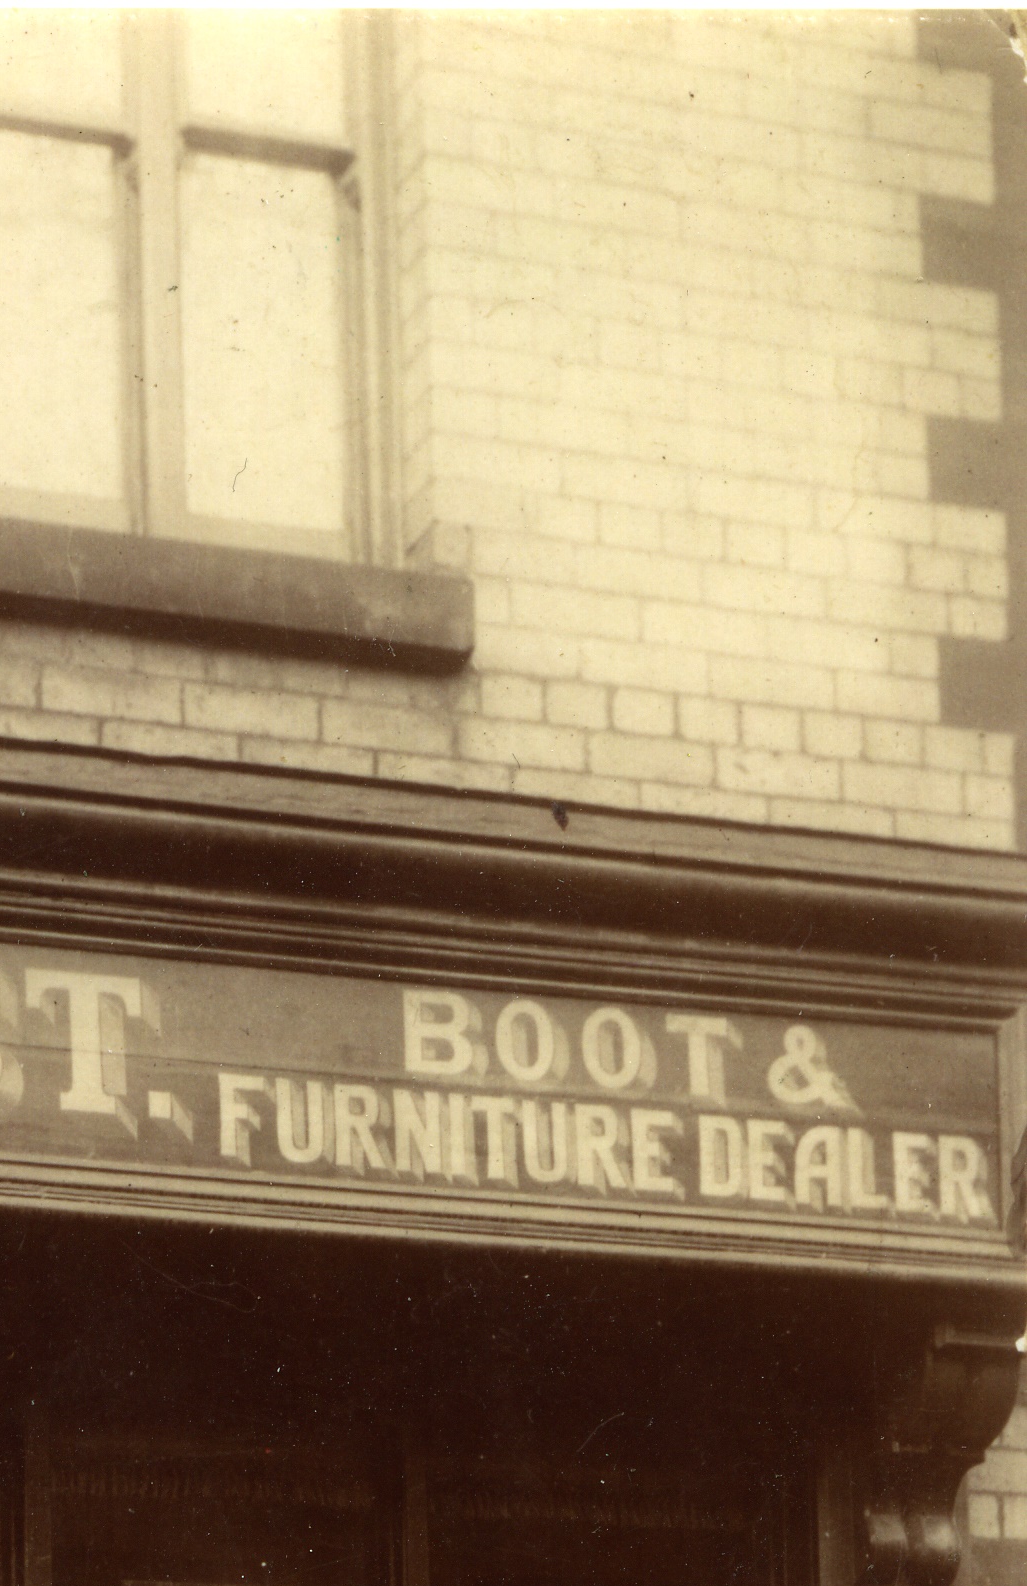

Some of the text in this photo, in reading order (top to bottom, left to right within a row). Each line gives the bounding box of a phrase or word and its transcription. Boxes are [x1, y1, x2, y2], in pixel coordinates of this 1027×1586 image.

[402, 988, 856, 1108] BOOT &
[218, 1071, 994, 1222] FURNITURE DEALER
